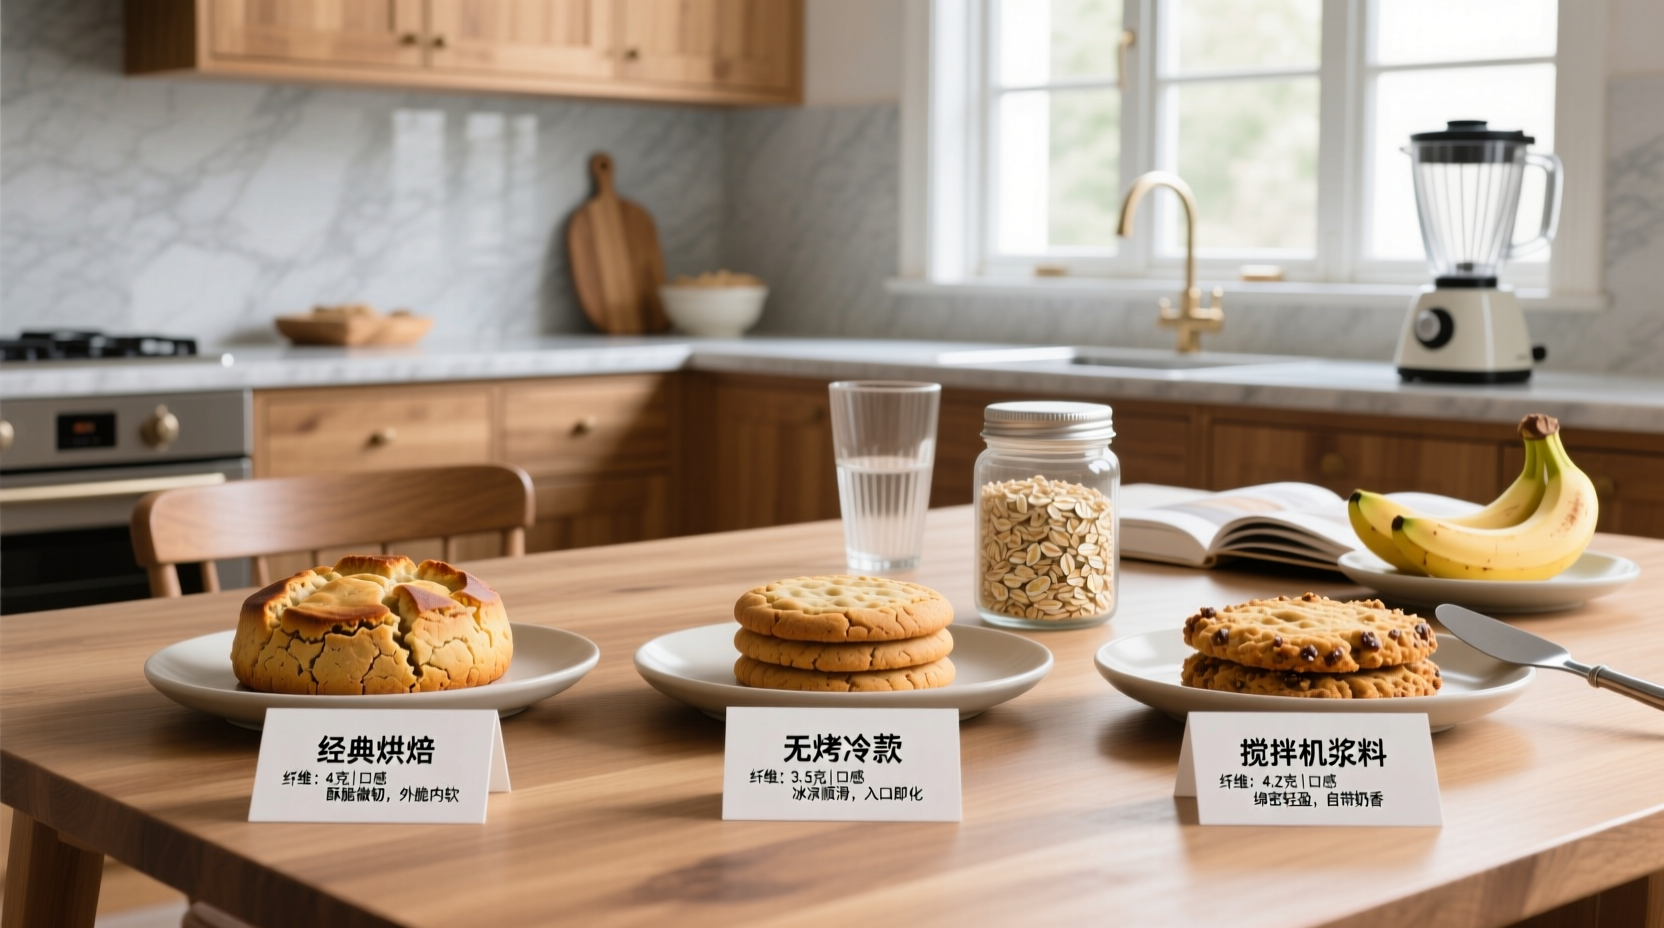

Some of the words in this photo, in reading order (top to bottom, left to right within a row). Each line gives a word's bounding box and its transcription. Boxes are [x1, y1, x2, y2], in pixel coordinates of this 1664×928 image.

[317, 735, 435, 764] 经典烘焙
[783, 733, 902, 763] 无烤冷款
[1240, 738, 1387, 767] 搅拌机浆料
